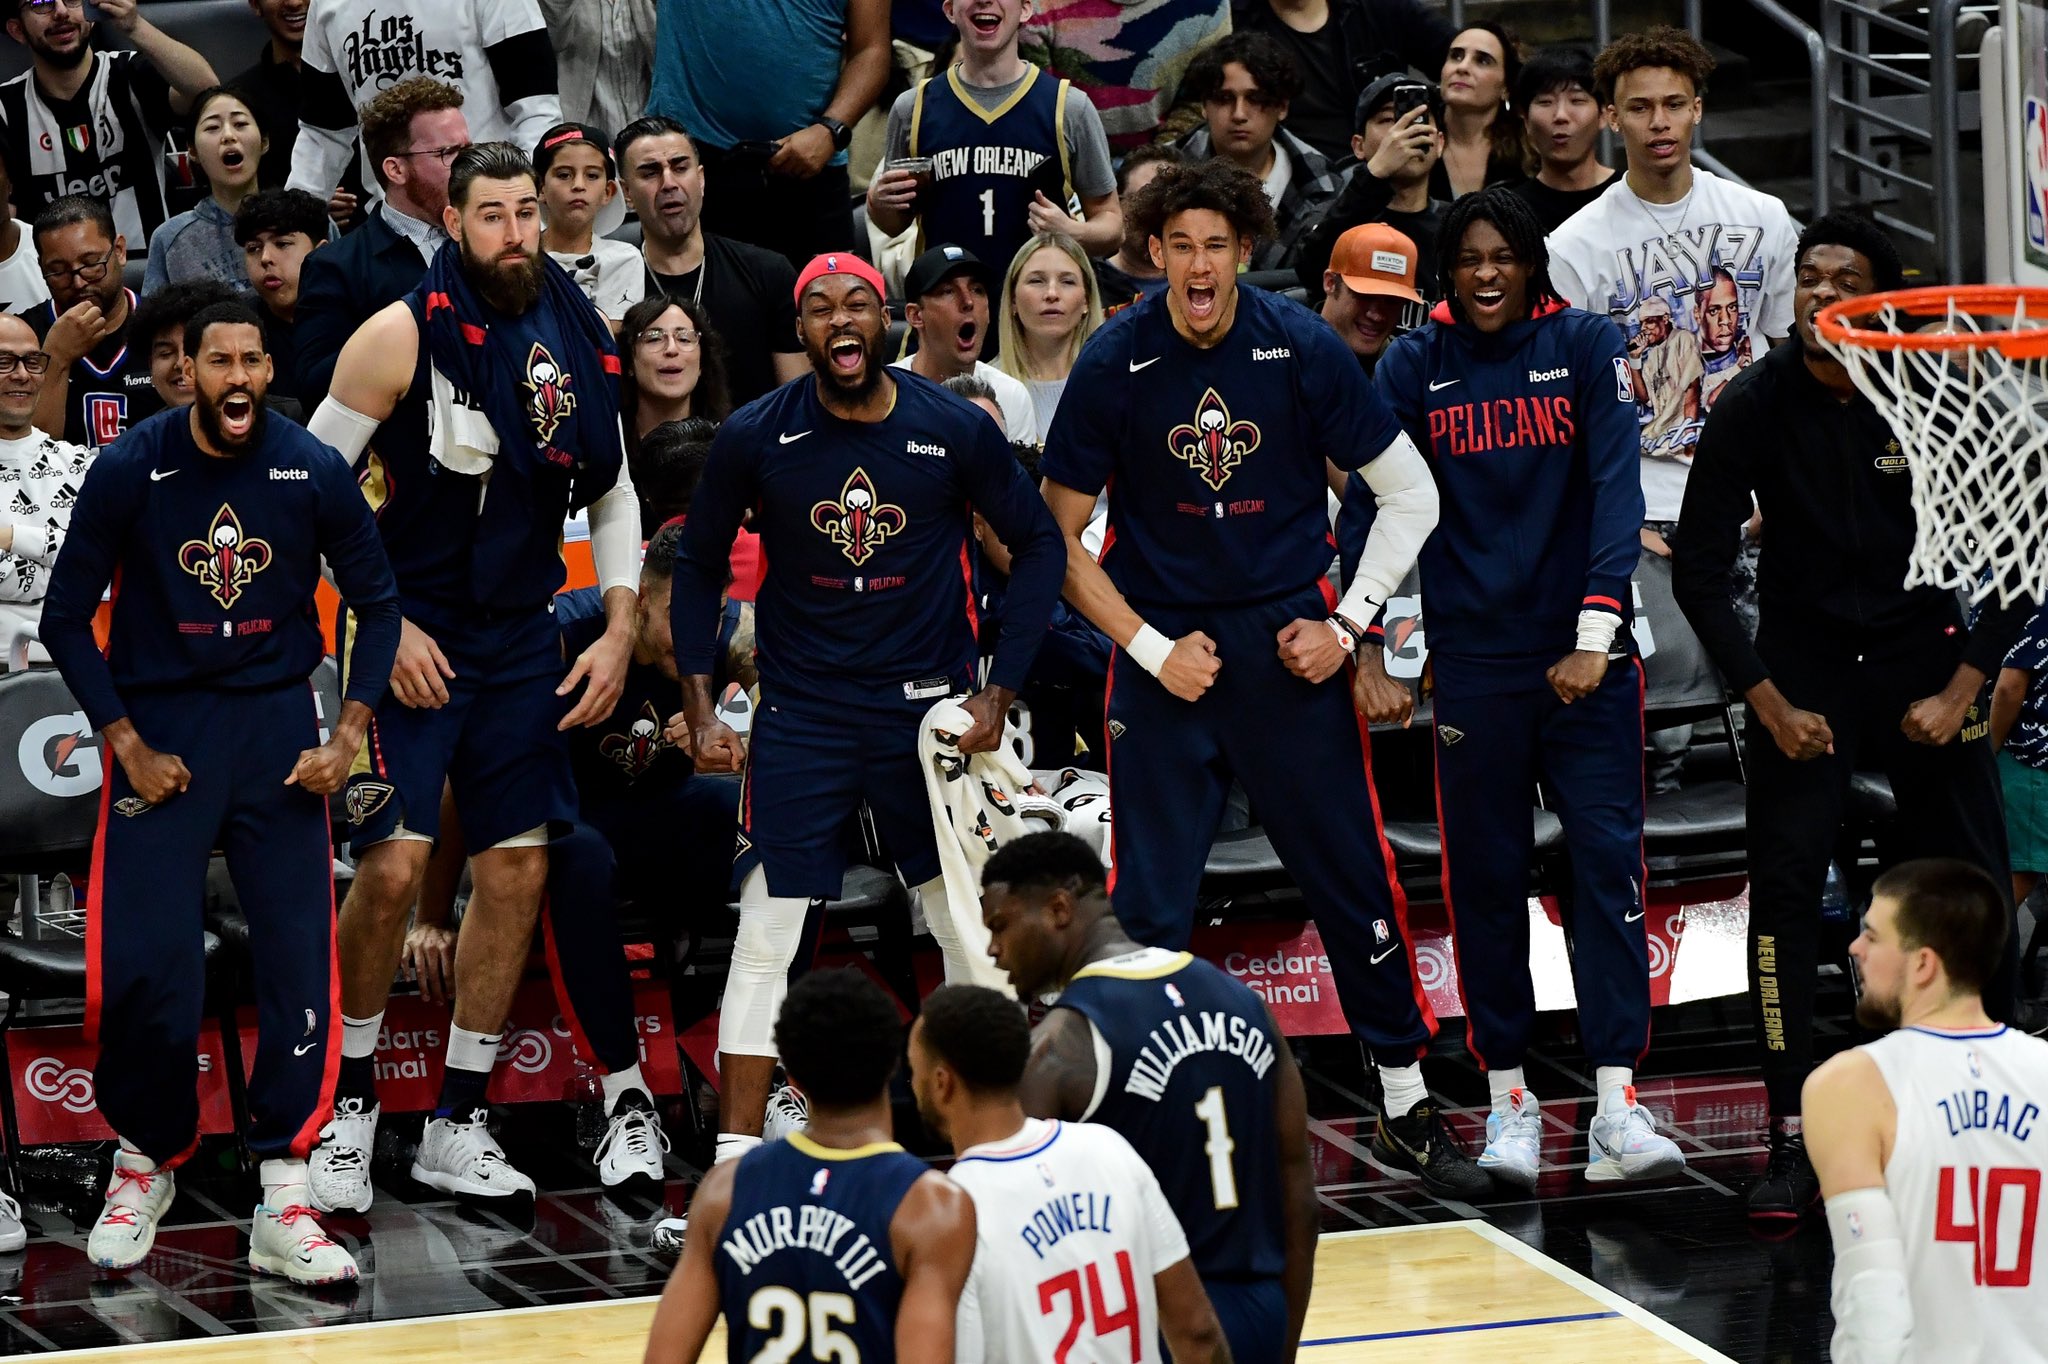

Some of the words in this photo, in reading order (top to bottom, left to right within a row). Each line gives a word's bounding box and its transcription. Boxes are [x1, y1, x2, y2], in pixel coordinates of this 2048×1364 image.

[361, 9, 413, 48] Los
[343, 30, 463, 91] Angeles
[933, 147, 970, 181] NEW
[44, 165, 121, 203] Jeep
[979, 189, 995, 236] 1
[1376, 256, 1403, 264] BRIXTON
[1252, 347, 1290, 361] ibotta
[123, 374, 154, 388] hone
[1529, 367, 1569, 383] ibotta
[1428, 396, 1576, 460] PELICANS
[907, 440, 946, 457] ibotta
[269, 467, 309, 480] ibotta
[50, 497, 76, 509] adid
[1229, 500, 1265, 516] PELICANS
[869, 576, 906, 592] PELICANS
[238, 619, 272, 636] PELICANS
[1224, 950, 1333, 976] Cedars
[1758, 935, 1776, 973] NEW
[1246, 977, 1320, 1004] Sinai
[1759, 976, 1786, 1051] ORLEANS
[374, 1025, 442, 1052] dars
[1124, 1011, 1276, 1102] WILLIAMSON
[374, 1053, 428, 1080] inai
[1937, 1090, 2040, 1142] ZUBAC
[1195, 1085, 1240, 1211] 1
[722, 1204, 856, 1276] MURPHY
[1021, 1192, 1112, 1259] POWELL
[1935, 1166, 2042, 1288] 40
[748, 1284, 862, 1364] 25
[1037, 1250, 1142, 1364] 24
